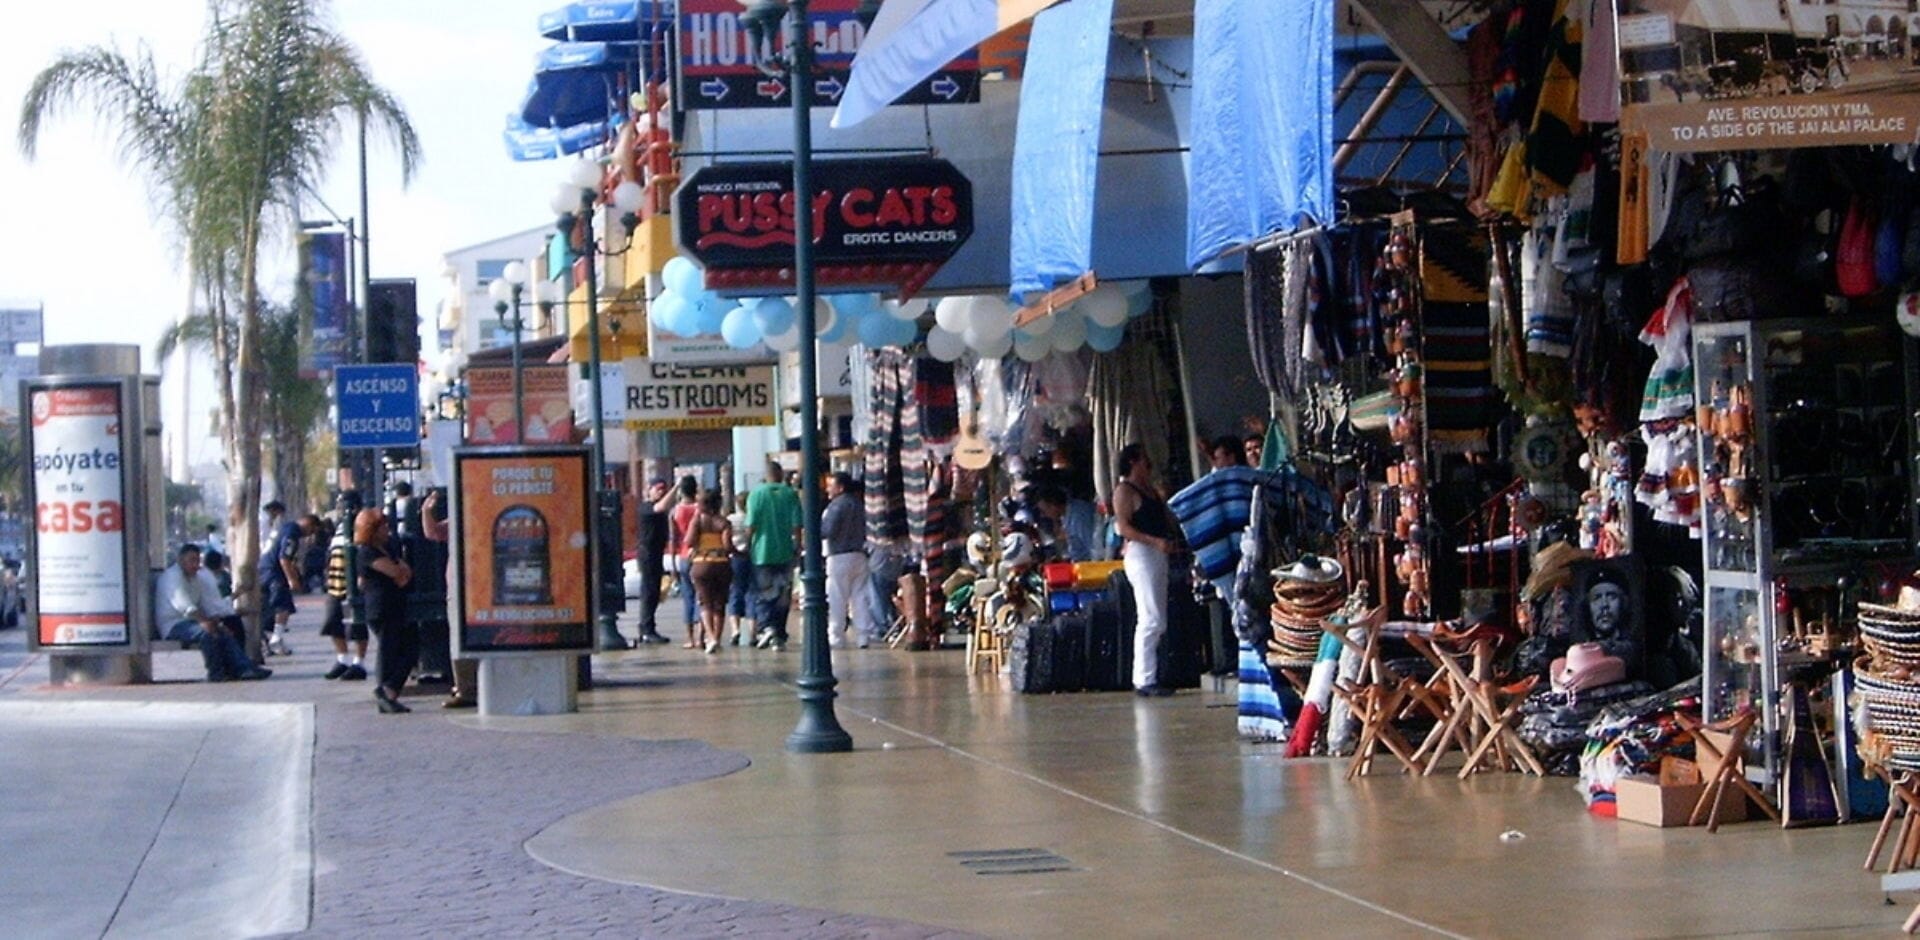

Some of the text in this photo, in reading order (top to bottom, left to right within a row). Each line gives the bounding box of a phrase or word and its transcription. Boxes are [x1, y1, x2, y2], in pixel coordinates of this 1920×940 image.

[1707, 107, 1738, 121] AVE.
[1741, 104, 1828, 120] REVOLUCION
[1830, 104, 1841, 117] Y
[1672, 117, 1905, 140] TO A SIDE OF THE JAI ALAI PALACE
[697, 185, 957, 243] PUSSY CATS
[843, 230, 957, 245] EROTIC DANCERS
[345, 378, 407, 394] ASCENSO
[627, 383, 768, 410] RESTROOMS
[372, 400, 381, 413] Y
[342, 417, 412, 434] DESCENSO
[34, 446, 120, 475] apóyate
[492, 481, 506, 496] LO
[36, 501, 125, 533] casa
